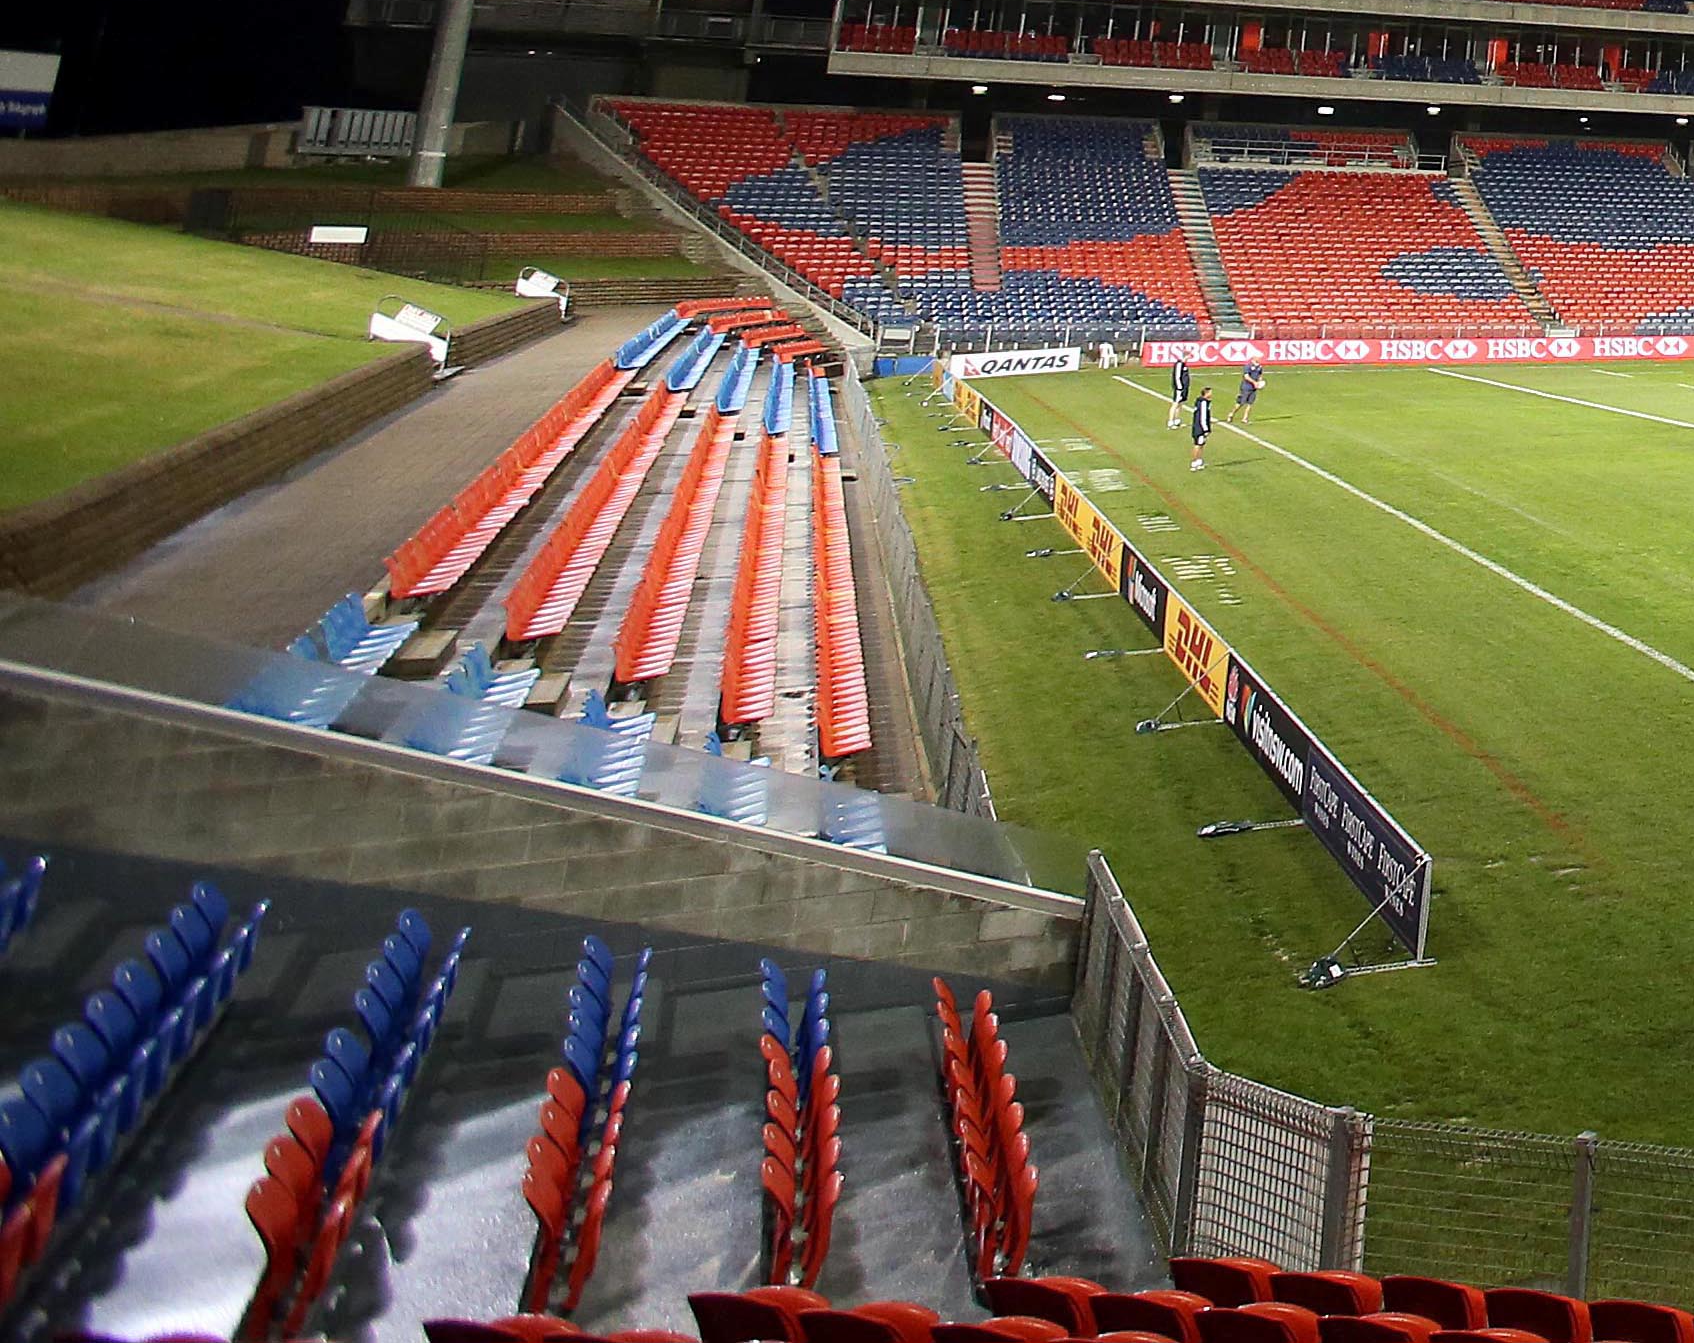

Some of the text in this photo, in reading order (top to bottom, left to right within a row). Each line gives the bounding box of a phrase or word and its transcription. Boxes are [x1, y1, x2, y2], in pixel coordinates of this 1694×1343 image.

[981, 354, 1069, 374] QANTAS
[1267, 341, 1334, 360] HSBC
[1380, 339, 1443, 359] HSBC
[1487, 338, 1547, 358] HSBC
[1593, 338, 1654, 356] HSBC
[1175, 608, 1213, 694] DHL
[1252, 705, 1304, 795] visitnsw.com
